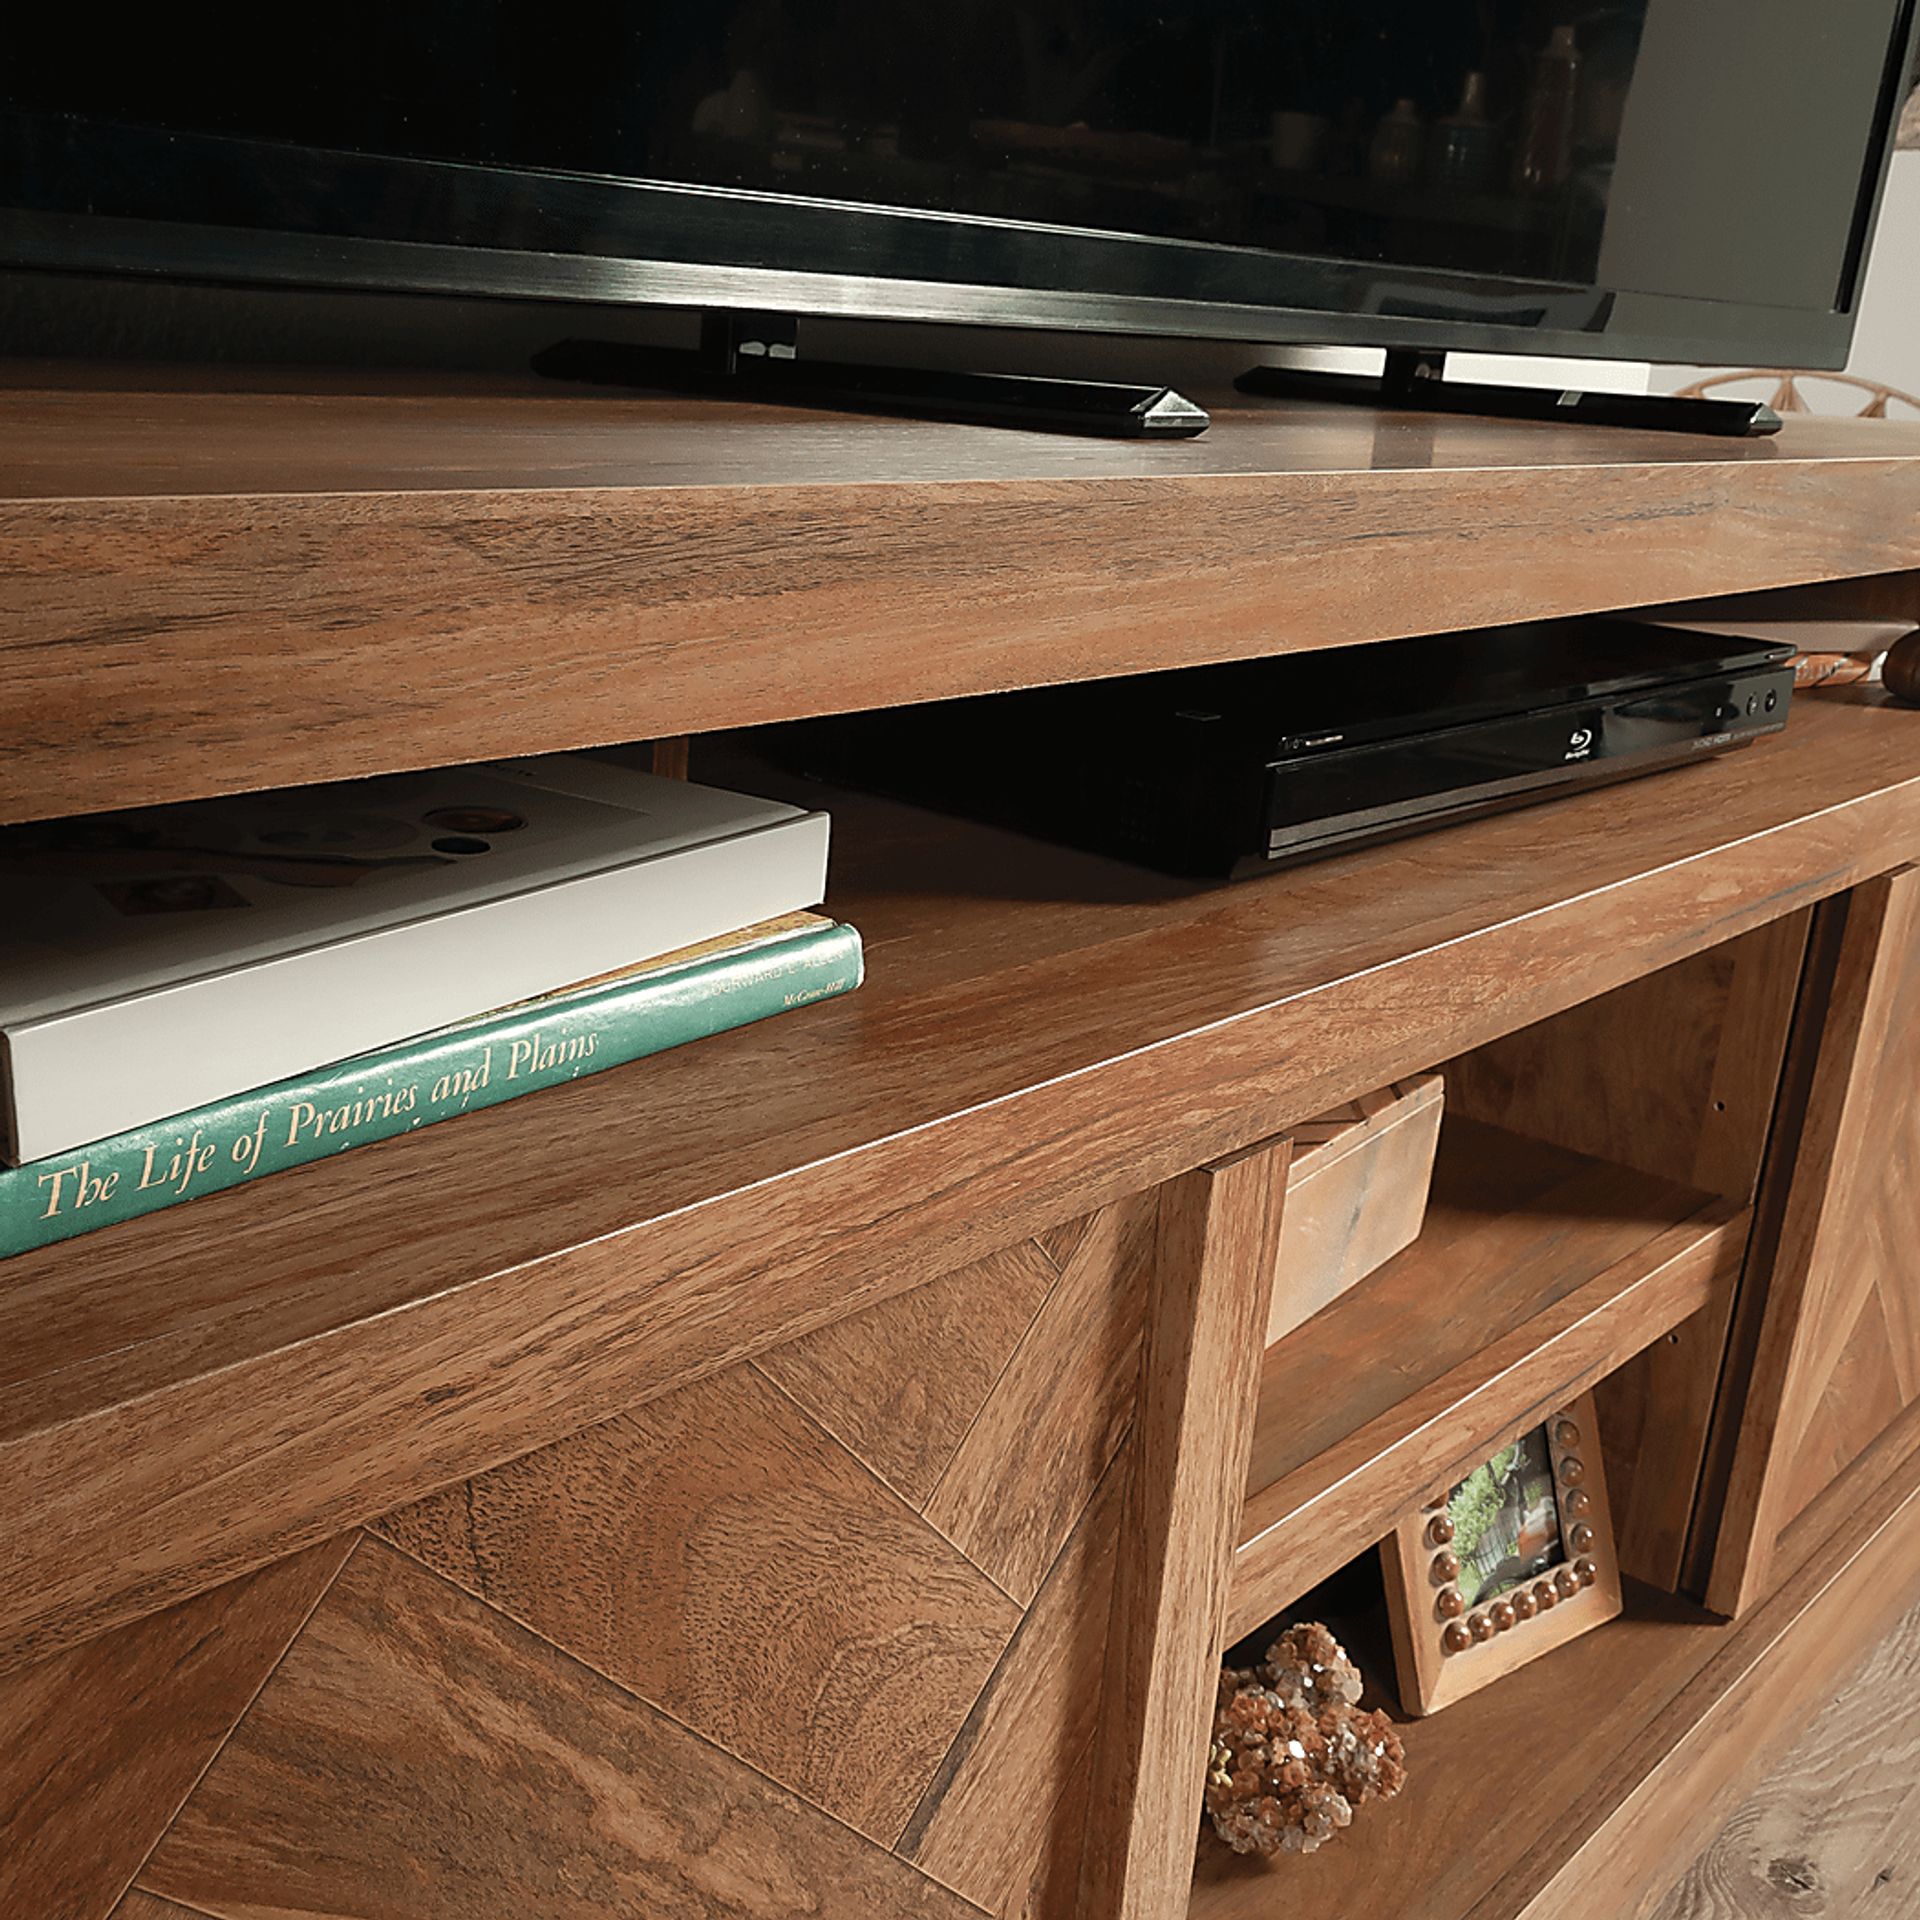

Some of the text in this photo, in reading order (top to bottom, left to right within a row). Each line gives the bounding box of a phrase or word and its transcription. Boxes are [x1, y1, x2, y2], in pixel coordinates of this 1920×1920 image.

[37, 1026, 598, 1220] The Life of Prairies and Plains
